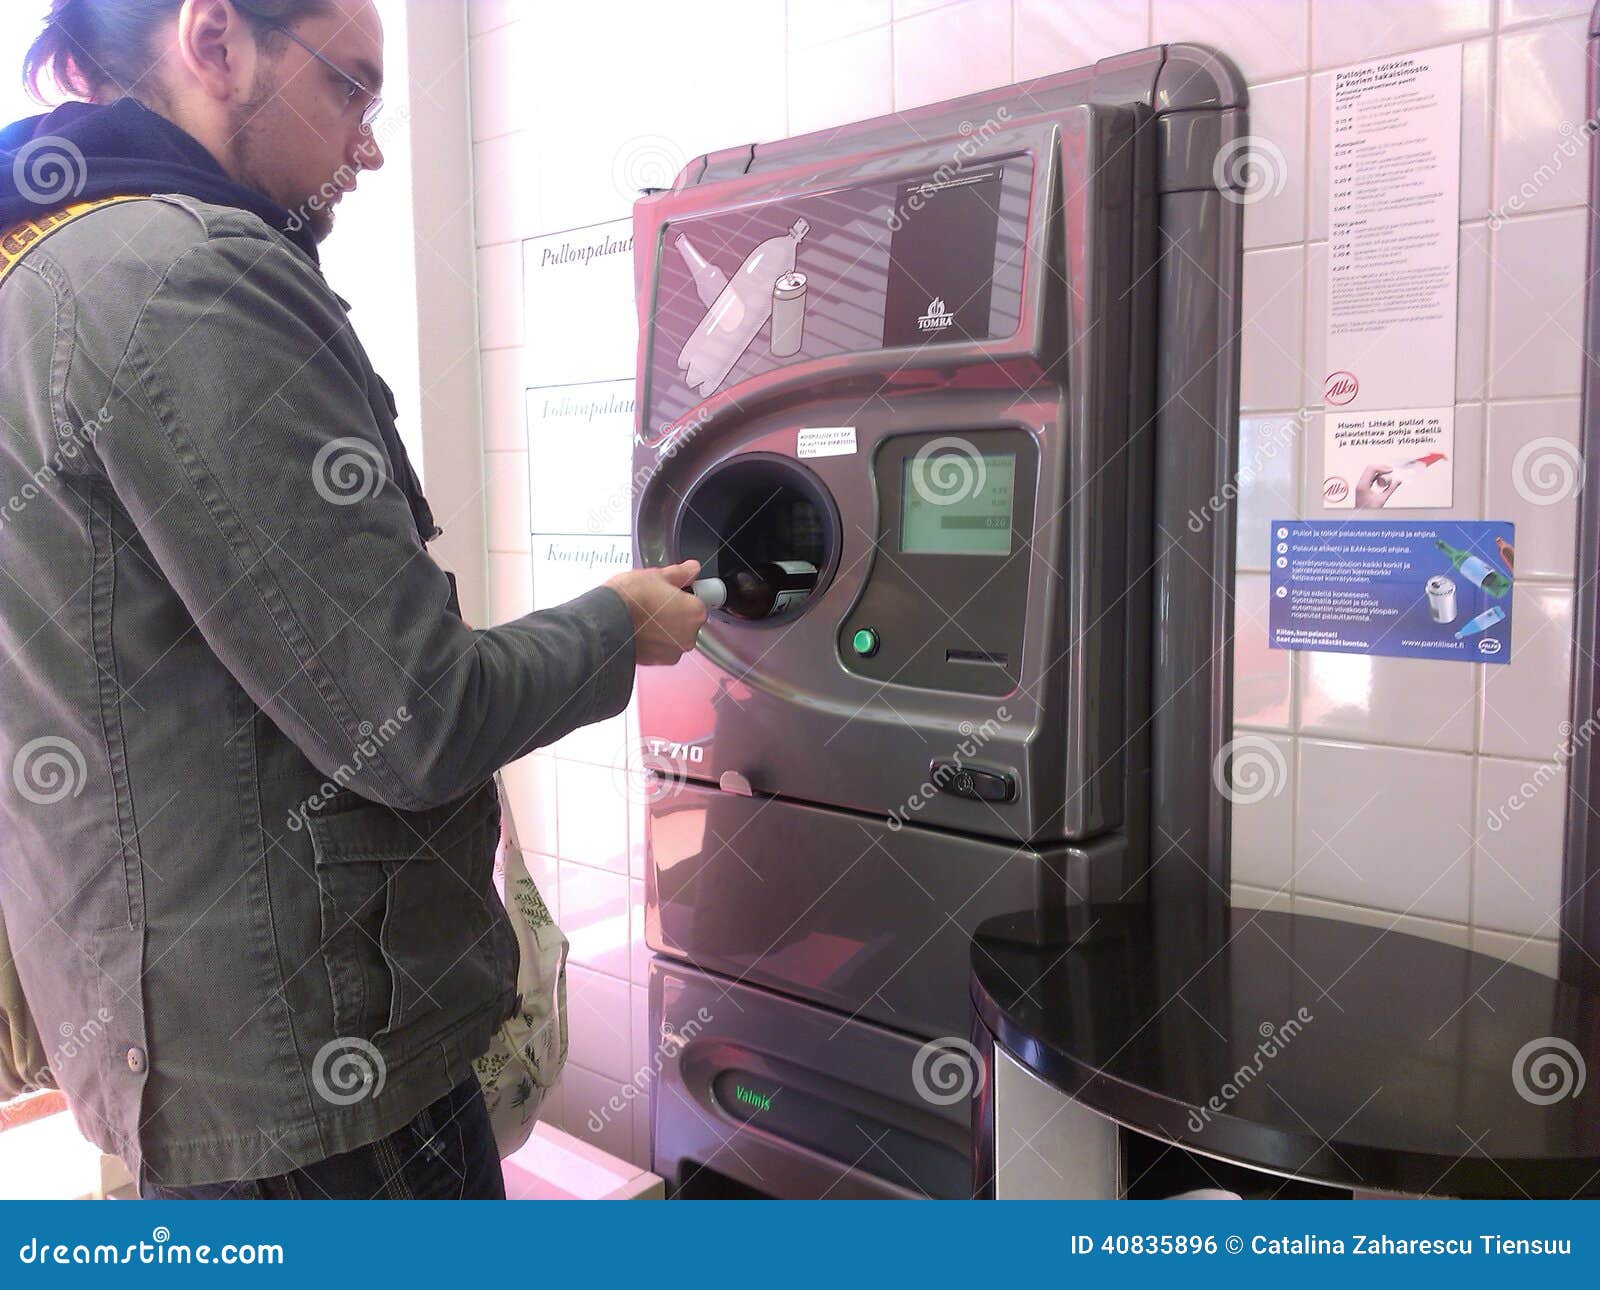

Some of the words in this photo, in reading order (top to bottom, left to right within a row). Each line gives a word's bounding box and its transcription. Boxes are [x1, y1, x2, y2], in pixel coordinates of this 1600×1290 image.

[917, 316, 952, 329] TOMRA
[1338, 421, 1365, 429] Huom!
[1399, 418, 1424, 427] pullot
[1388, 428, 1411, 437] pohja
[1338, 440, 1347, 448] ja
[1350, 438, 1394, 447] EAN-koodi
[650, 740, 703, 763] T-710
[736, 1085, 770, 1111] Valmis
